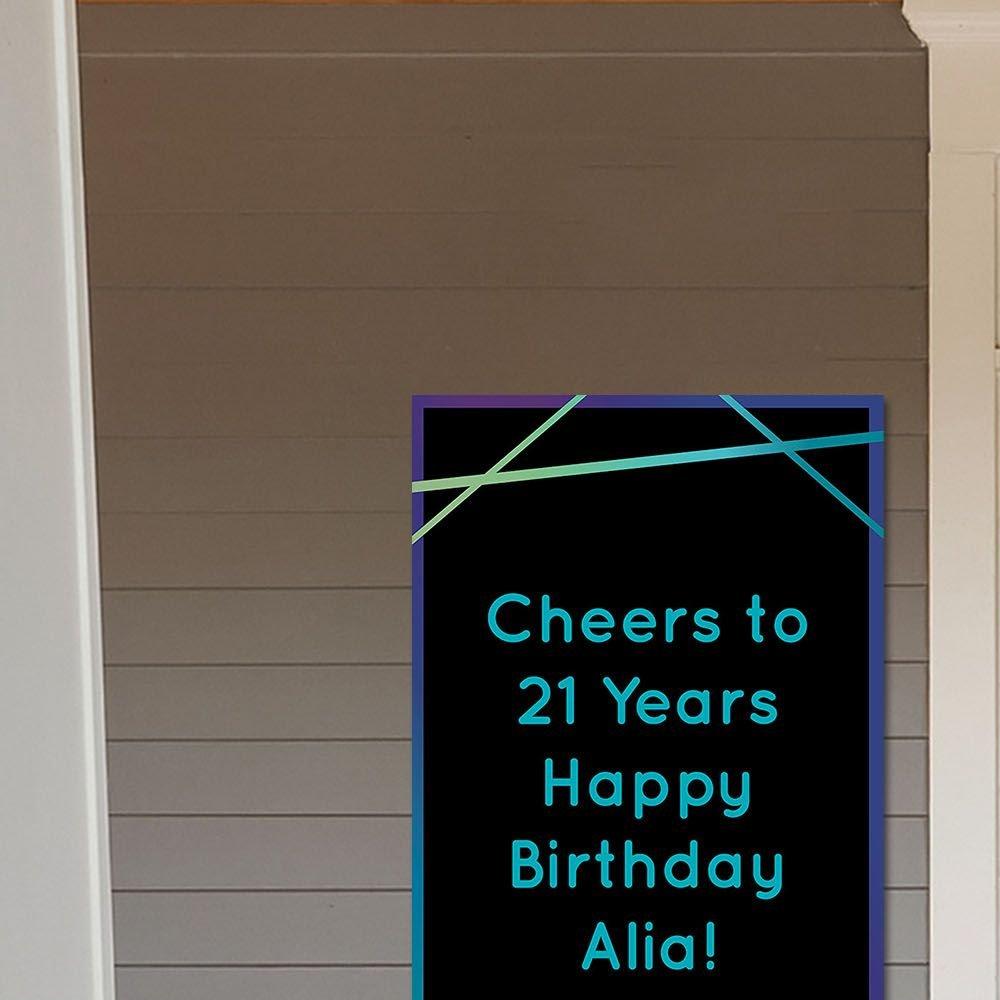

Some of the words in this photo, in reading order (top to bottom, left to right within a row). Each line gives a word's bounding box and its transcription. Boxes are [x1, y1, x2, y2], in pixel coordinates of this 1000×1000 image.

[487, 592, 721, 644] Cheers
[745, 592, 808, 644] to
[517, 675, 575, 725] 21
[602, 675, 778, 725] Years
[544, 757, 751, 820] Happy
[511, 839, 783, 900] Birthday
[581, 921, 719, 971] Alia!
